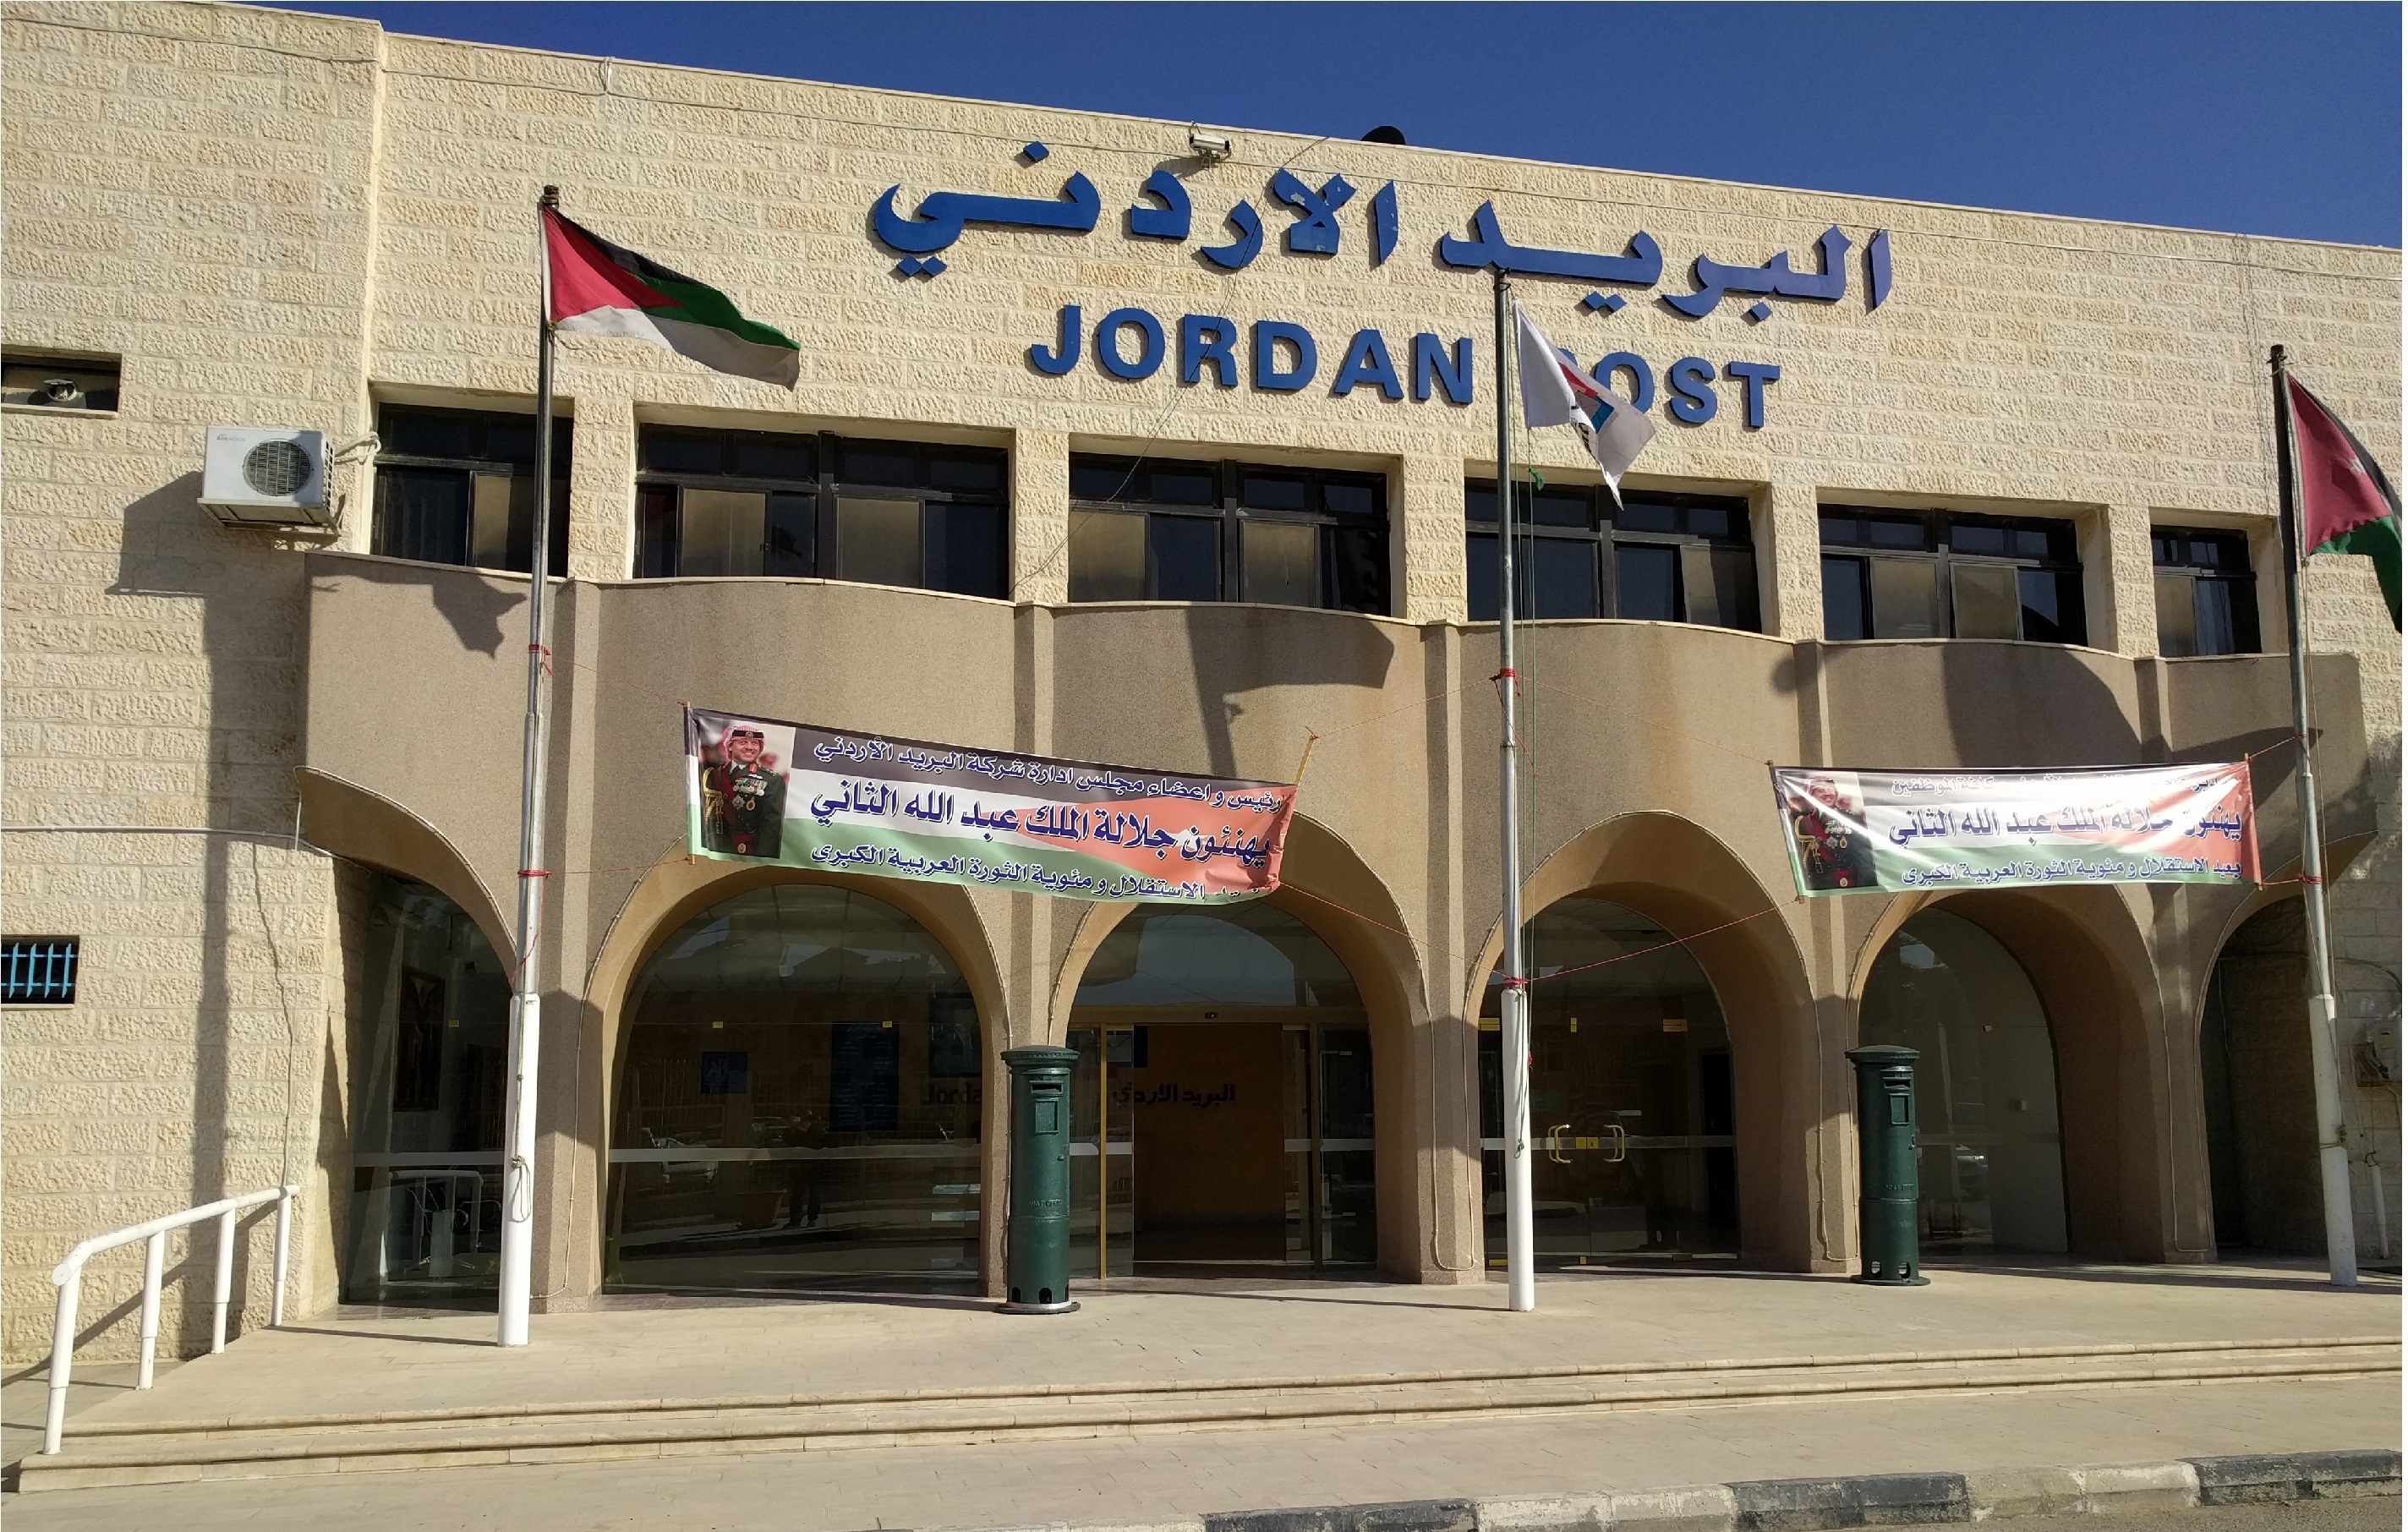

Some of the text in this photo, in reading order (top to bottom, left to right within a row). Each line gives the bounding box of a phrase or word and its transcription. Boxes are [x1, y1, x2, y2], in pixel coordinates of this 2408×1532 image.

[873, 140, 1893, 323] البريد الاردني
[1030, 304, 1781, 429] JORDAN OST
[814, 736, 894, 763] الأردني
[898, 749, 965, 774] البريد
[966, 752, 1026, 780] شركة
[1027, 762, 1074, 785] ادارة
[1075, 771, 1144, 795] مجلس
[1147, 778, 1211, 802] اعضاء
[1227, 791, 1281, 813] رئيس
[811, 779, 1270, 868] يهنئون جلالة الملك عبد الله الثاني
[1889, 807, 1956, 850] الثاني
[1961, 807, 2000, 835] الله
[2006, 812, 2054, 846] عبد
[2057, 806, 2107, 834] الملك
[811, 845, 884, 867] الكبرى
[887, 846, 966, 876] العربية
[2072, 857, 2125, 879] مئوية
[2139, 856, 2209, 878] الاستقلال
[968, 857, 1029, 884] الثورة
[1031, 864, 1092, 890] مئوية
[1902, 862, 1959, 886] الكبرى
[1959, 861, 2023, 884] العربية
[2023, 859, 2072, 881] الثورة
[2213, 860, 2242, 878] بعيد
[1109, 874, 1205, 899] الاستقلال
[920, 1082, 982, 1105] Jorda
[1182, 1083, 1236, 1108] البريد
